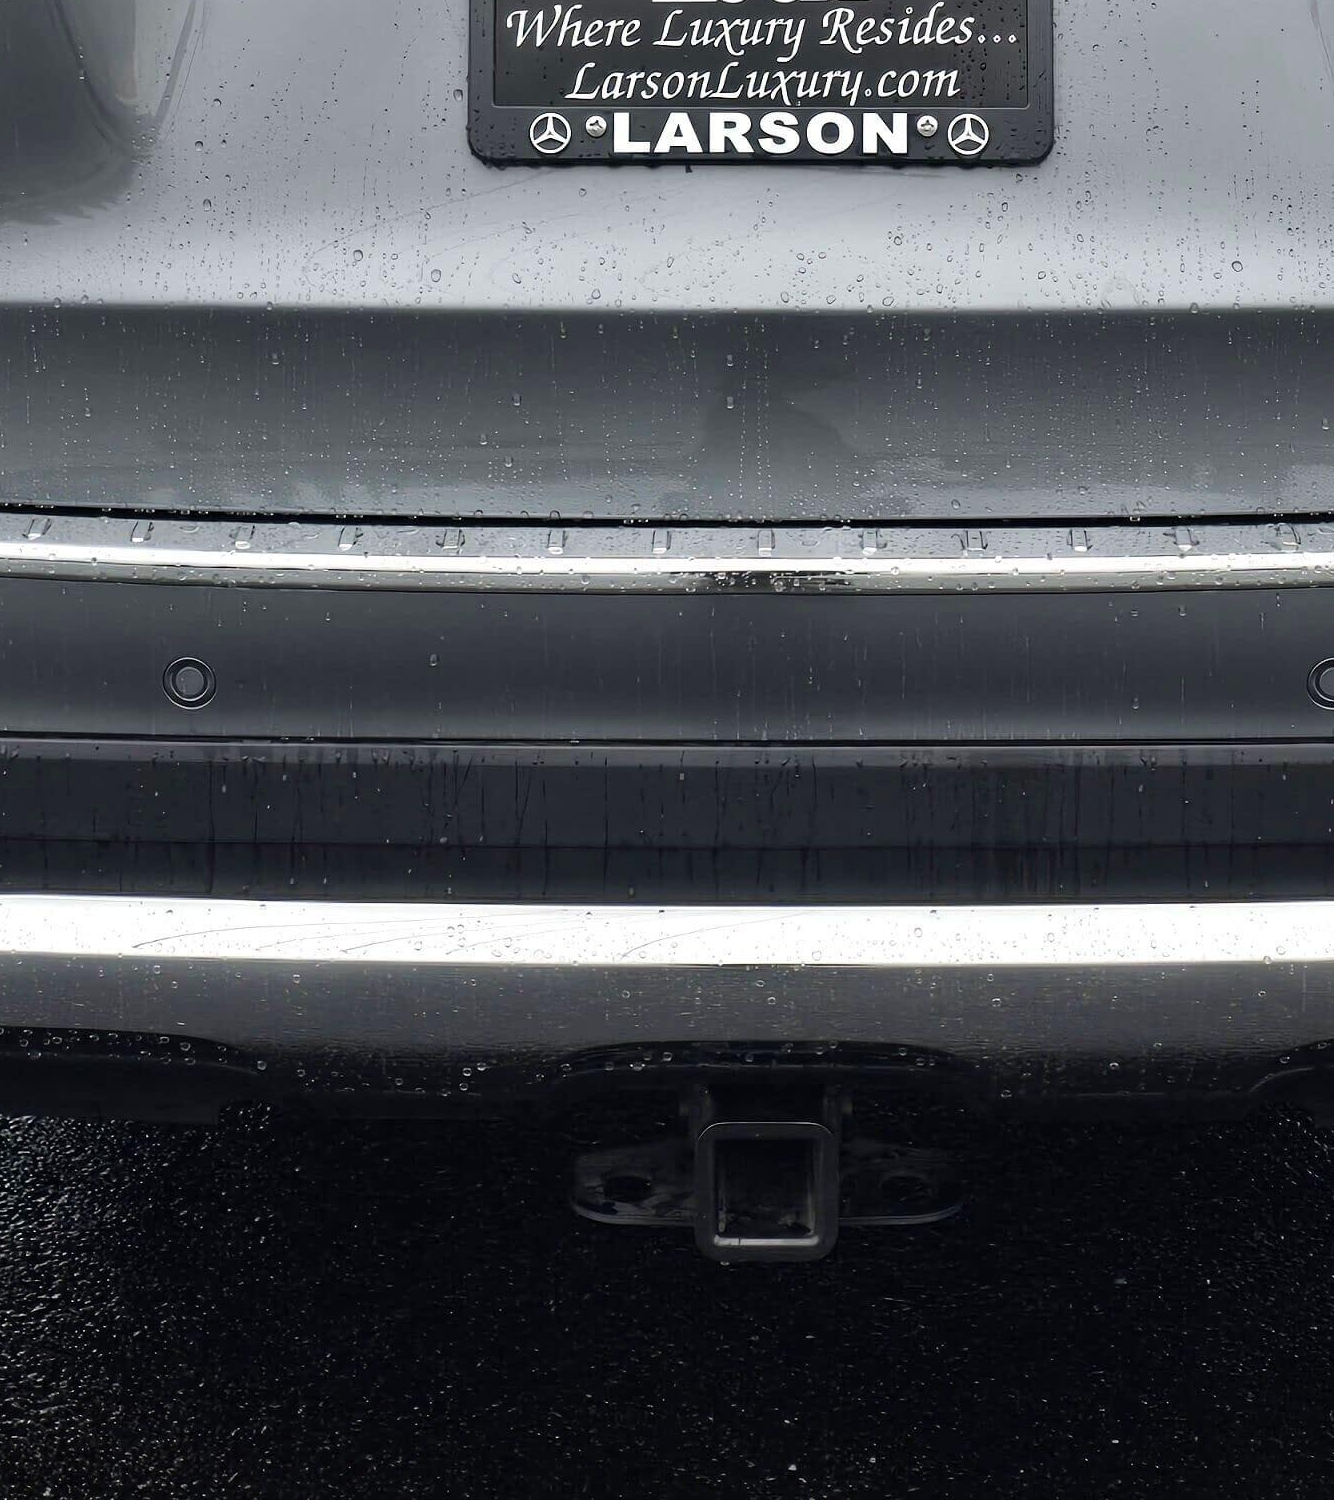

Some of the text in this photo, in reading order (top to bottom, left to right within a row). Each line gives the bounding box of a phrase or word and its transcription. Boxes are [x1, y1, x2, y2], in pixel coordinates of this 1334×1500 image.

[506, 1, 1017, 62] Where Luxury Resides...
[564, 61, 961, 106] LarsonLuxury.com
[612, 111, 908, 154] LARSON
